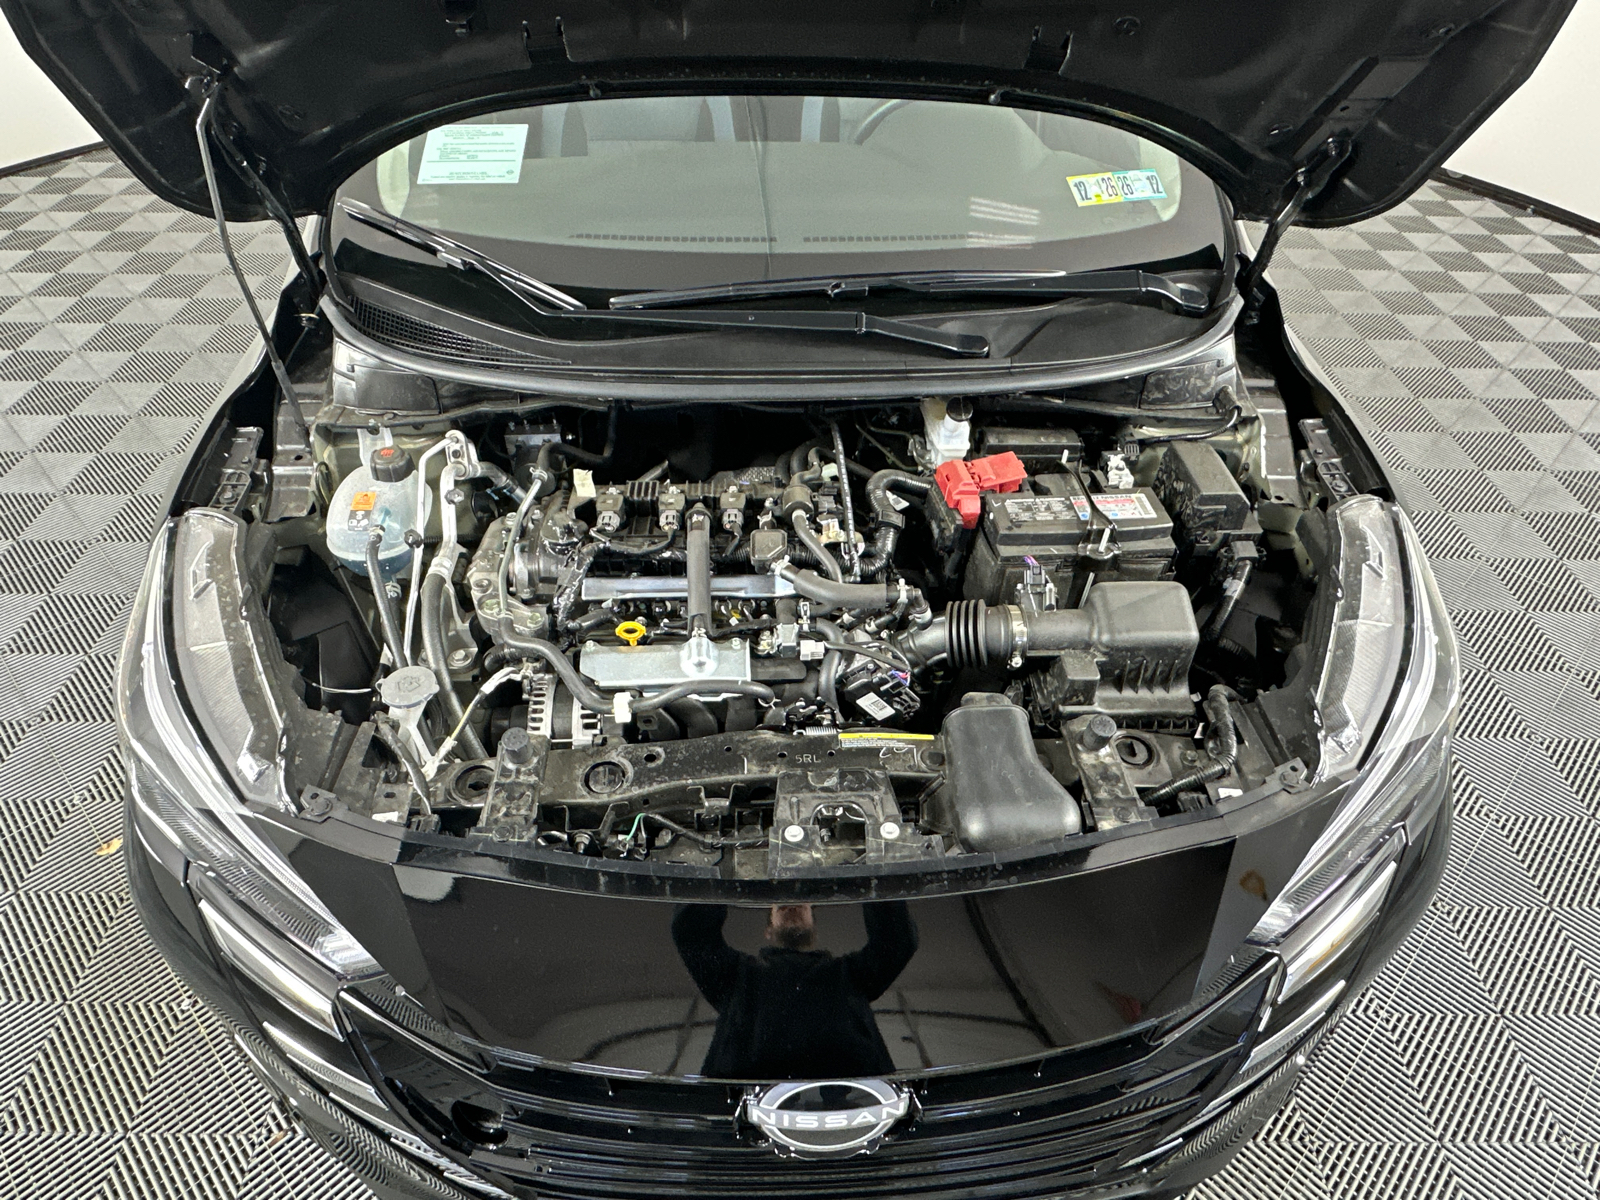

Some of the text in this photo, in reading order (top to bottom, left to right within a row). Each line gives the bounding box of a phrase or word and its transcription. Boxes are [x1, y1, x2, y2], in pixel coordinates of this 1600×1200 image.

[1073, 176, 1119, 201] 12 26
[1117, 174, 1163, 196] 26 12
[752, 1101, 904, 1128] NISSAN
